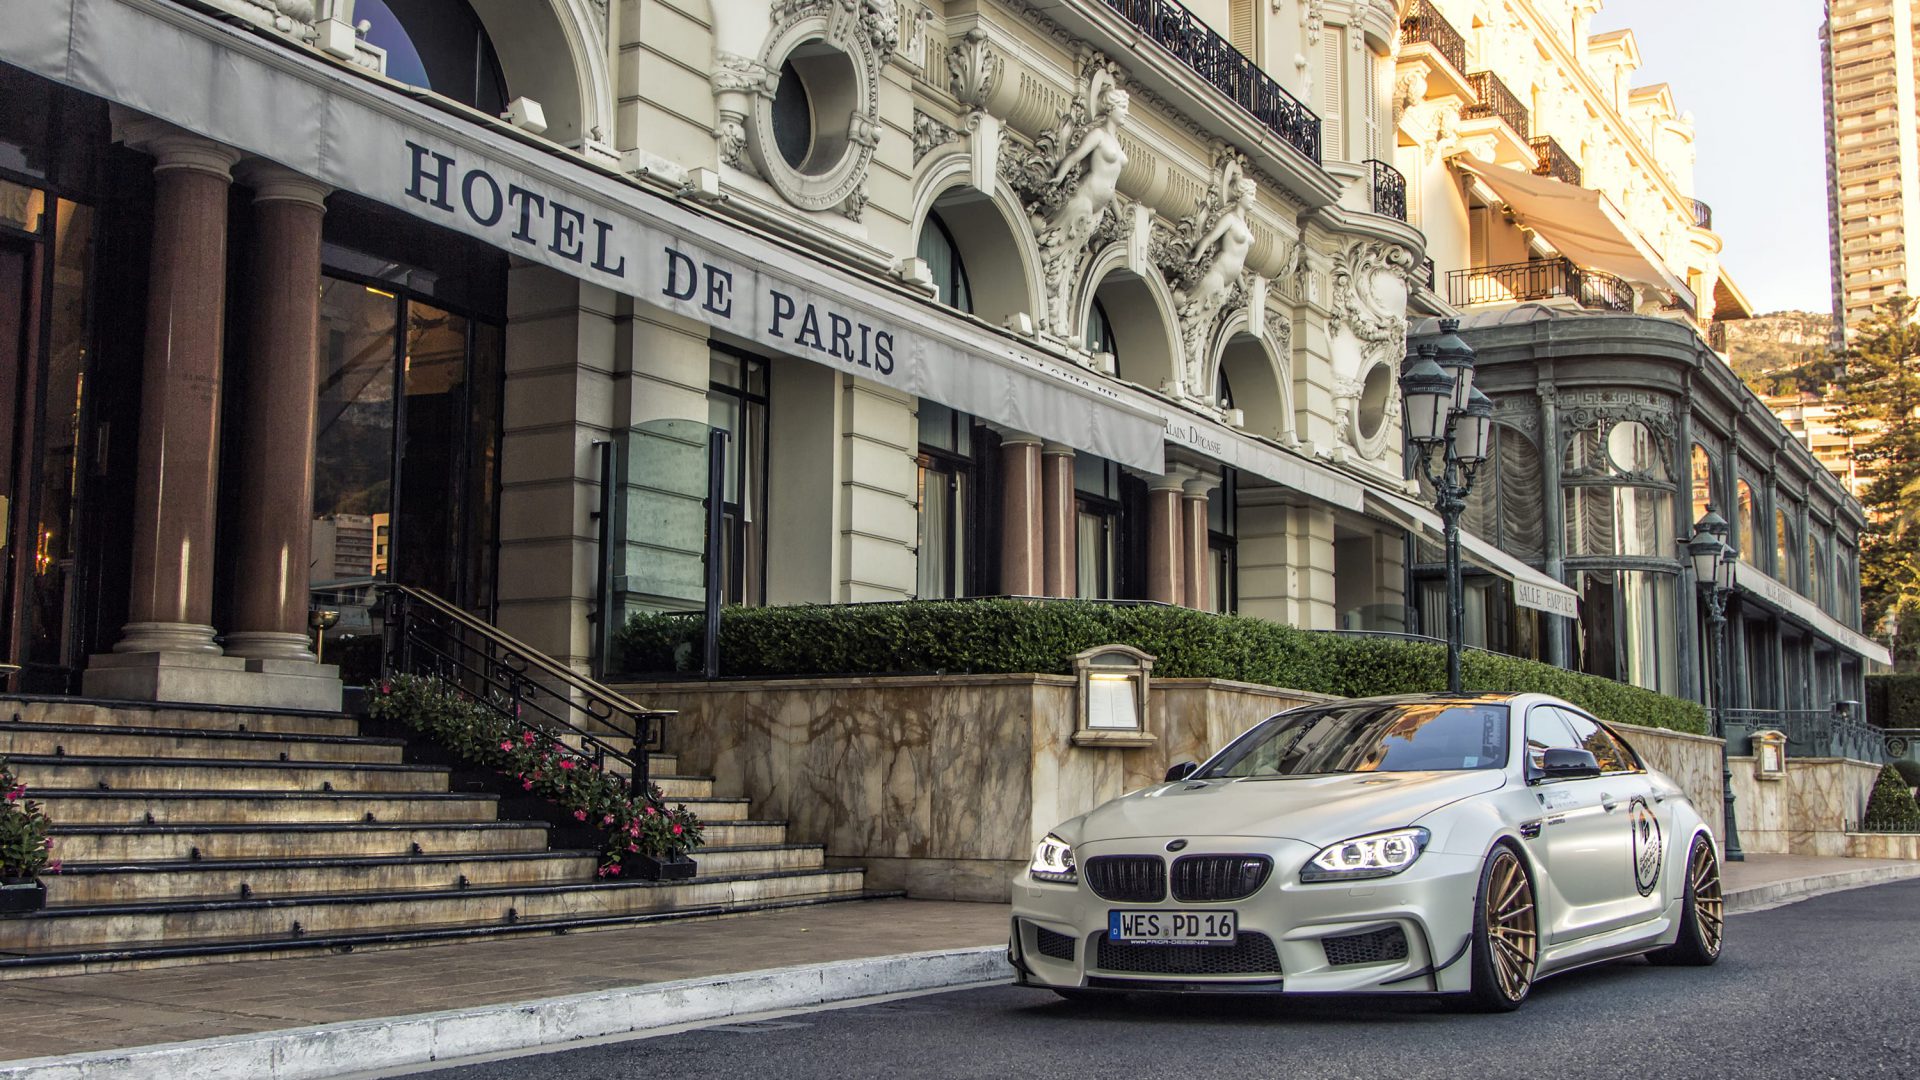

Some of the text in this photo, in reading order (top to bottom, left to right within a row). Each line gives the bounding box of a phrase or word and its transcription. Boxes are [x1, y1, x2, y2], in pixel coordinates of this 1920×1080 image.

[405, 140, 895, 375] HOTEL DE PARIS
[1519, 585, 1541, 605] SALLE
[1122, 915, 1160, 936] WES
[1173, 915, 1199, 936] PD
[1205, 915, 1231, 936] 16
